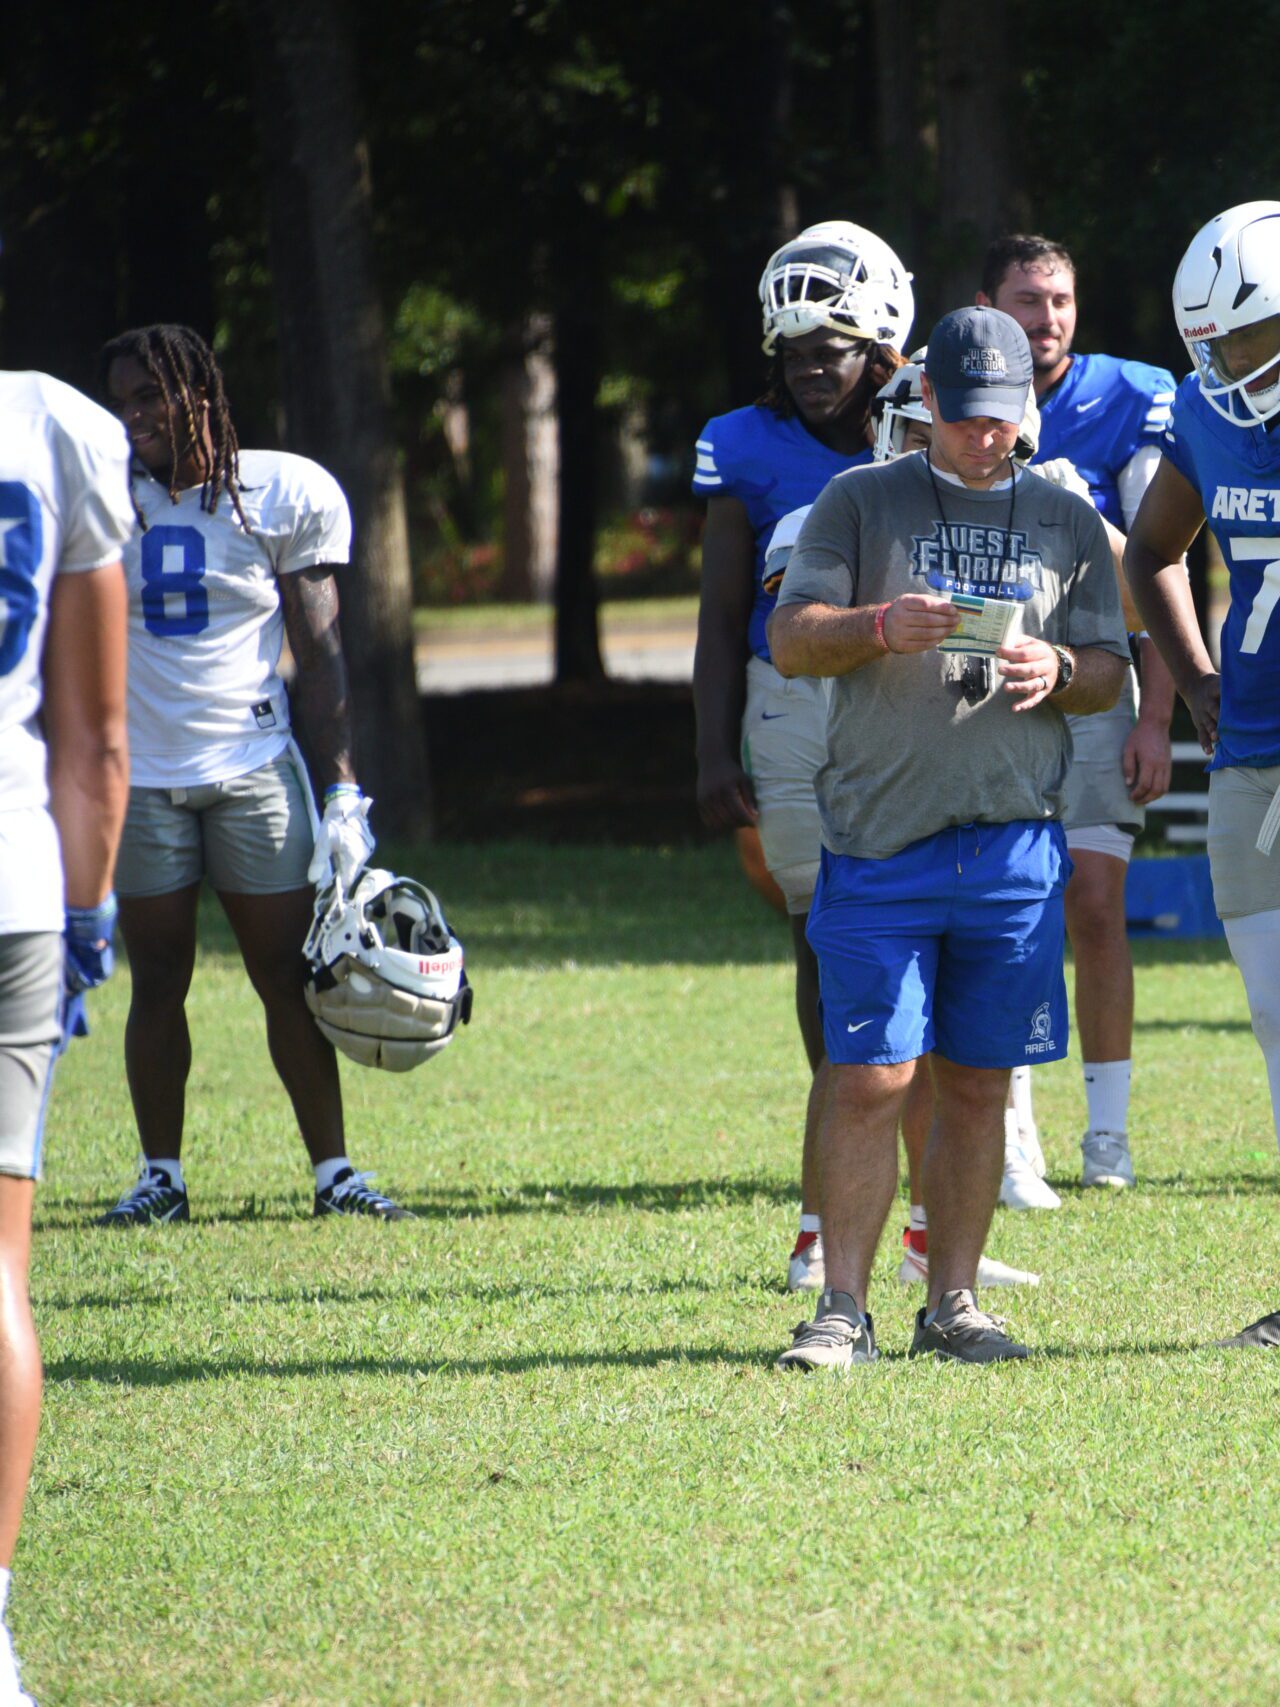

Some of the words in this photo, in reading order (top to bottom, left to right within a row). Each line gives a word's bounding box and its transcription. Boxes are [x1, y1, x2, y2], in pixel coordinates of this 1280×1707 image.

[1183, 322, 1217, 338] Riddell
[963, 357, 1006, 371] FLORIDA
[940, 525, 1024, 560] WEST
[920, 541, 1043, 590] FLORIDA
[141, 525, 209, 637] 8
[946, 579, 1014, 595] FOOTBALL
[1025, 1040, 1056, 1055] ARETE
